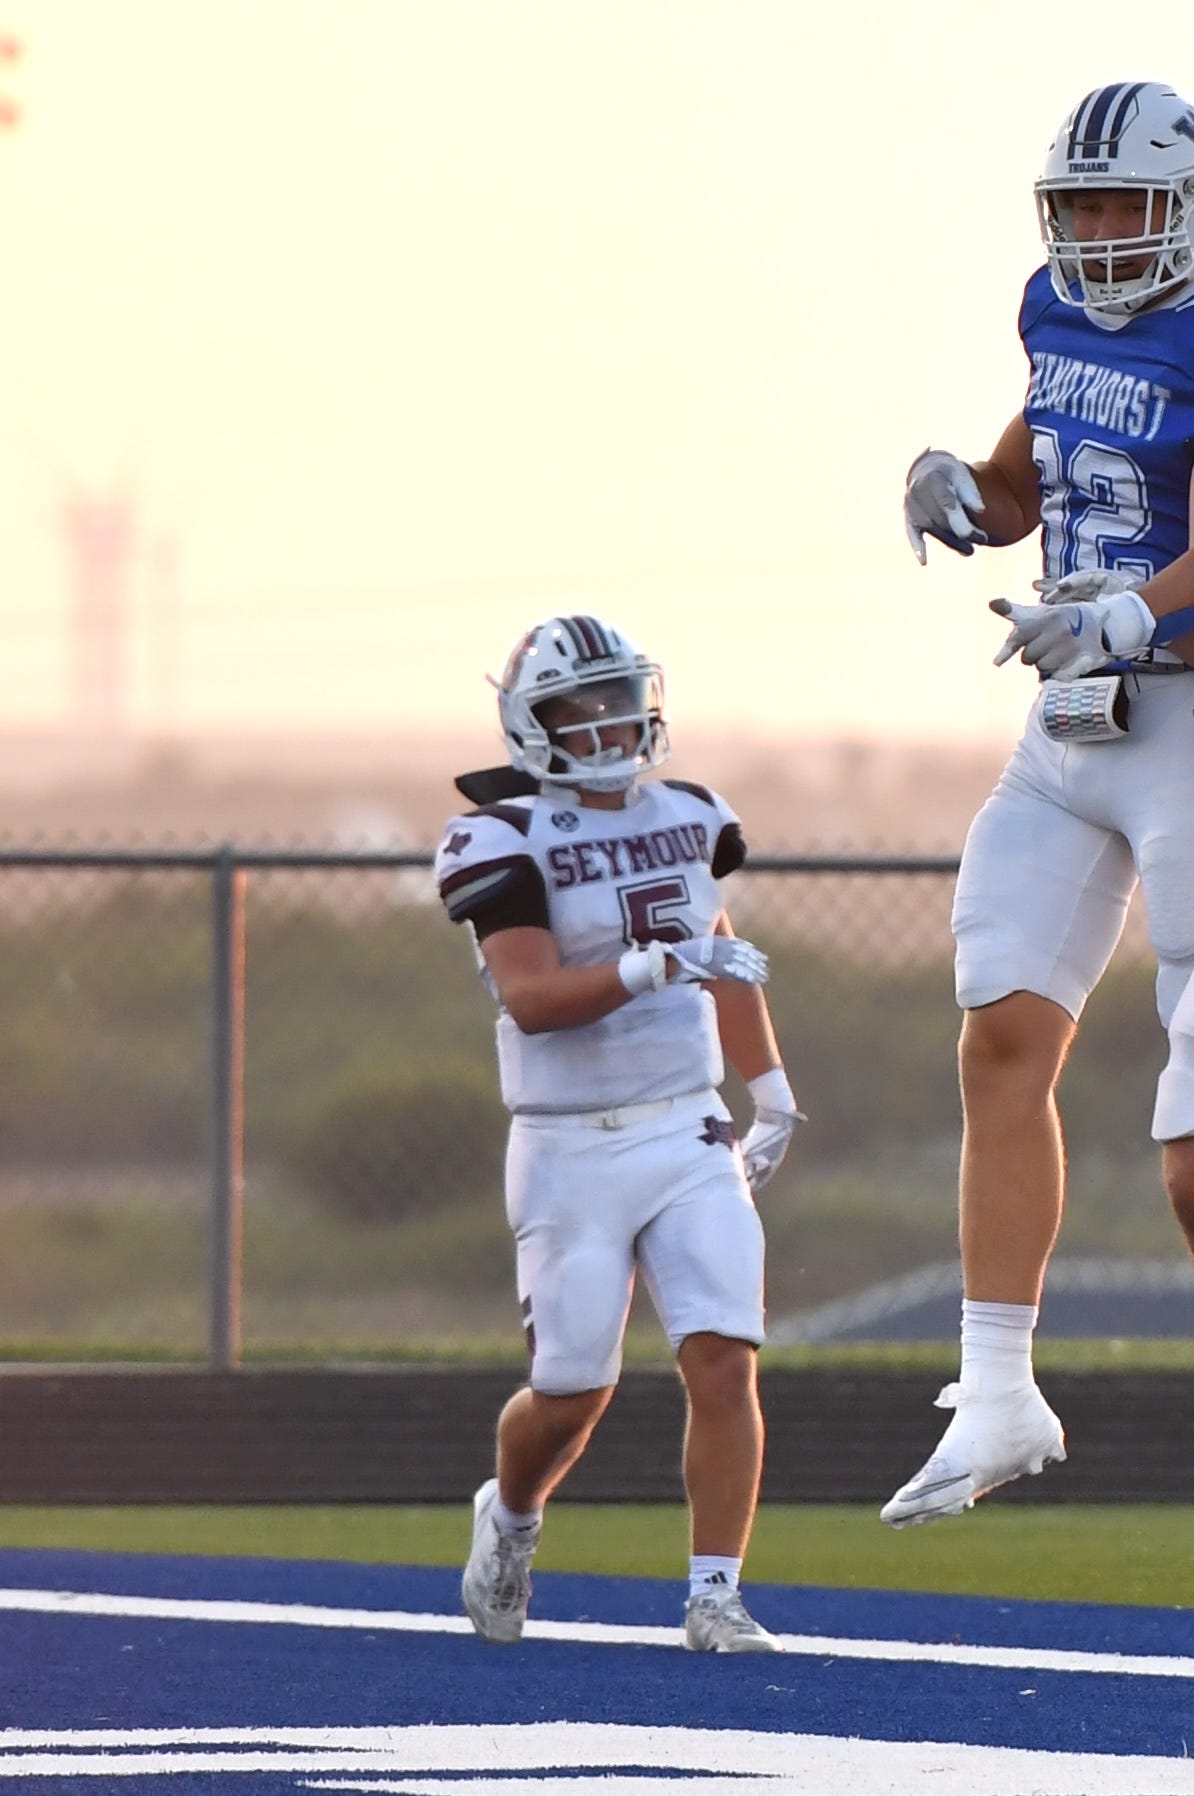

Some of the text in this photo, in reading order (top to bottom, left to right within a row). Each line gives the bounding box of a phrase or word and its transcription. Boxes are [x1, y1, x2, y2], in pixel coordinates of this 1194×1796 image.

[1069, 162, 1109, 173] TROJANS
[547, 823, 708, 892] SEYMOUR
[616, 875, 693, 950] 5
